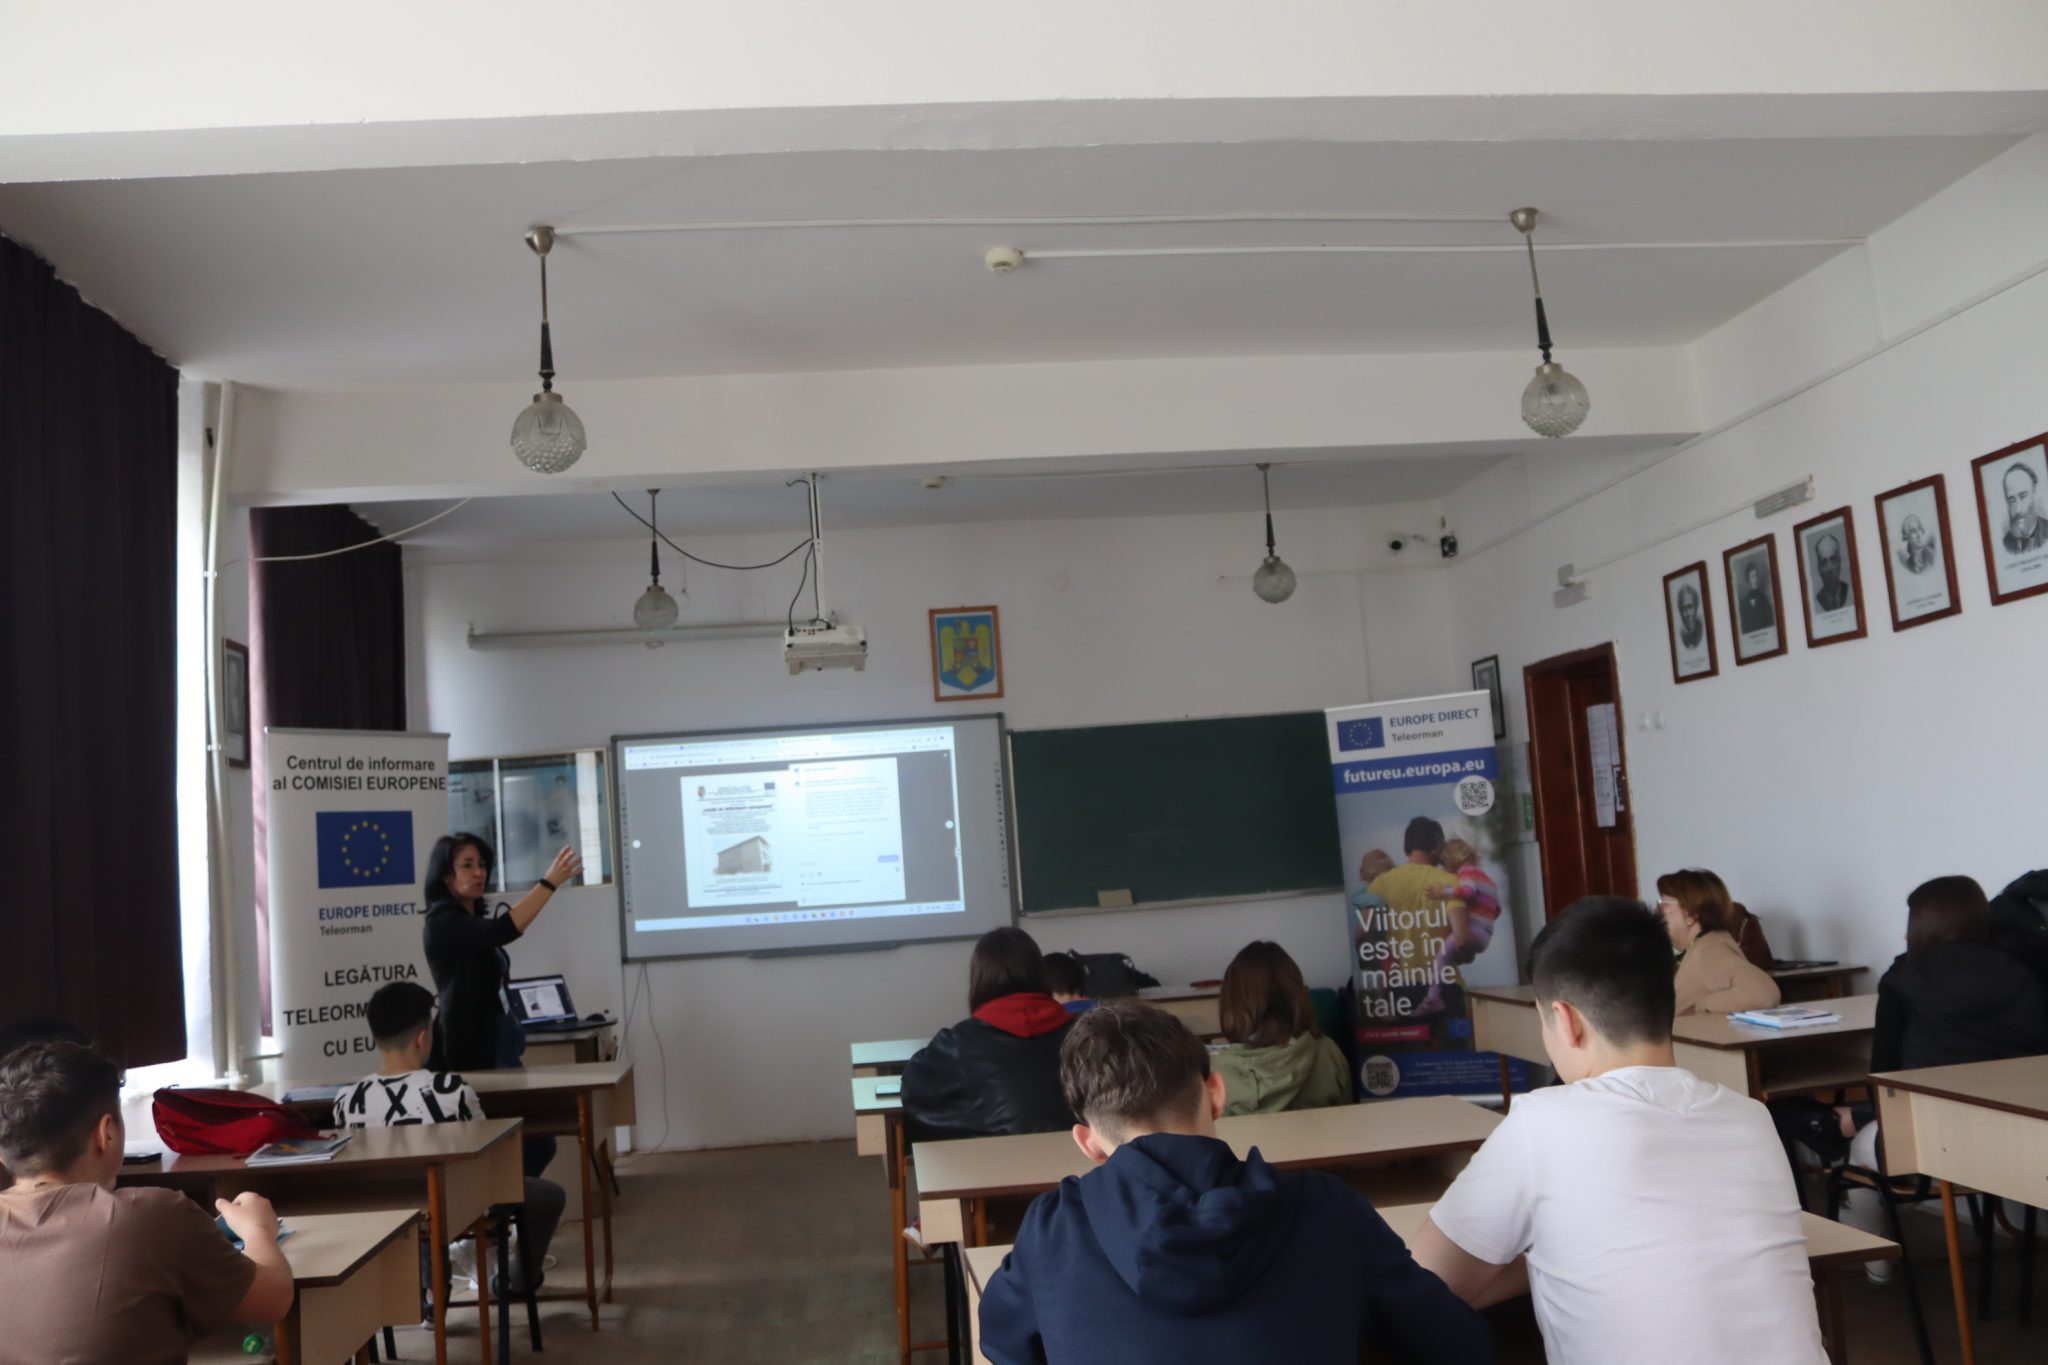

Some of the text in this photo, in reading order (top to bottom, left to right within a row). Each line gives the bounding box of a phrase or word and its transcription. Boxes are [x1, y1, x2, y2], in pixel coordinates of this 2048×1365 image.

[1390, 708, 1479, 727] EUROPE DIRECT
[1392, 729, 1444, 742] Teleorman
[287, 755, 435, 771] Centrul de informare
[1344, 759, 1485, 784] futureu.europa.eu
[272, 776, 446, 791] al COMISIEI EUROPENE
[319, 902, 417, 920] EUROPE DIRECT
[1356, 901, 1448, 932] Viitorul
[320, 924, 373, 936] Teleorman
[1360, 932, 1446, 961] este în
[324, 963, 418, 987] LEGĂTURA
[1362, 960, 1456, 989] mâinile
[283, 1002, 368, 1026] TELEORM
[1363, 991, 1412, 1018] tale
[323, 1039, 347, 1057] CU
